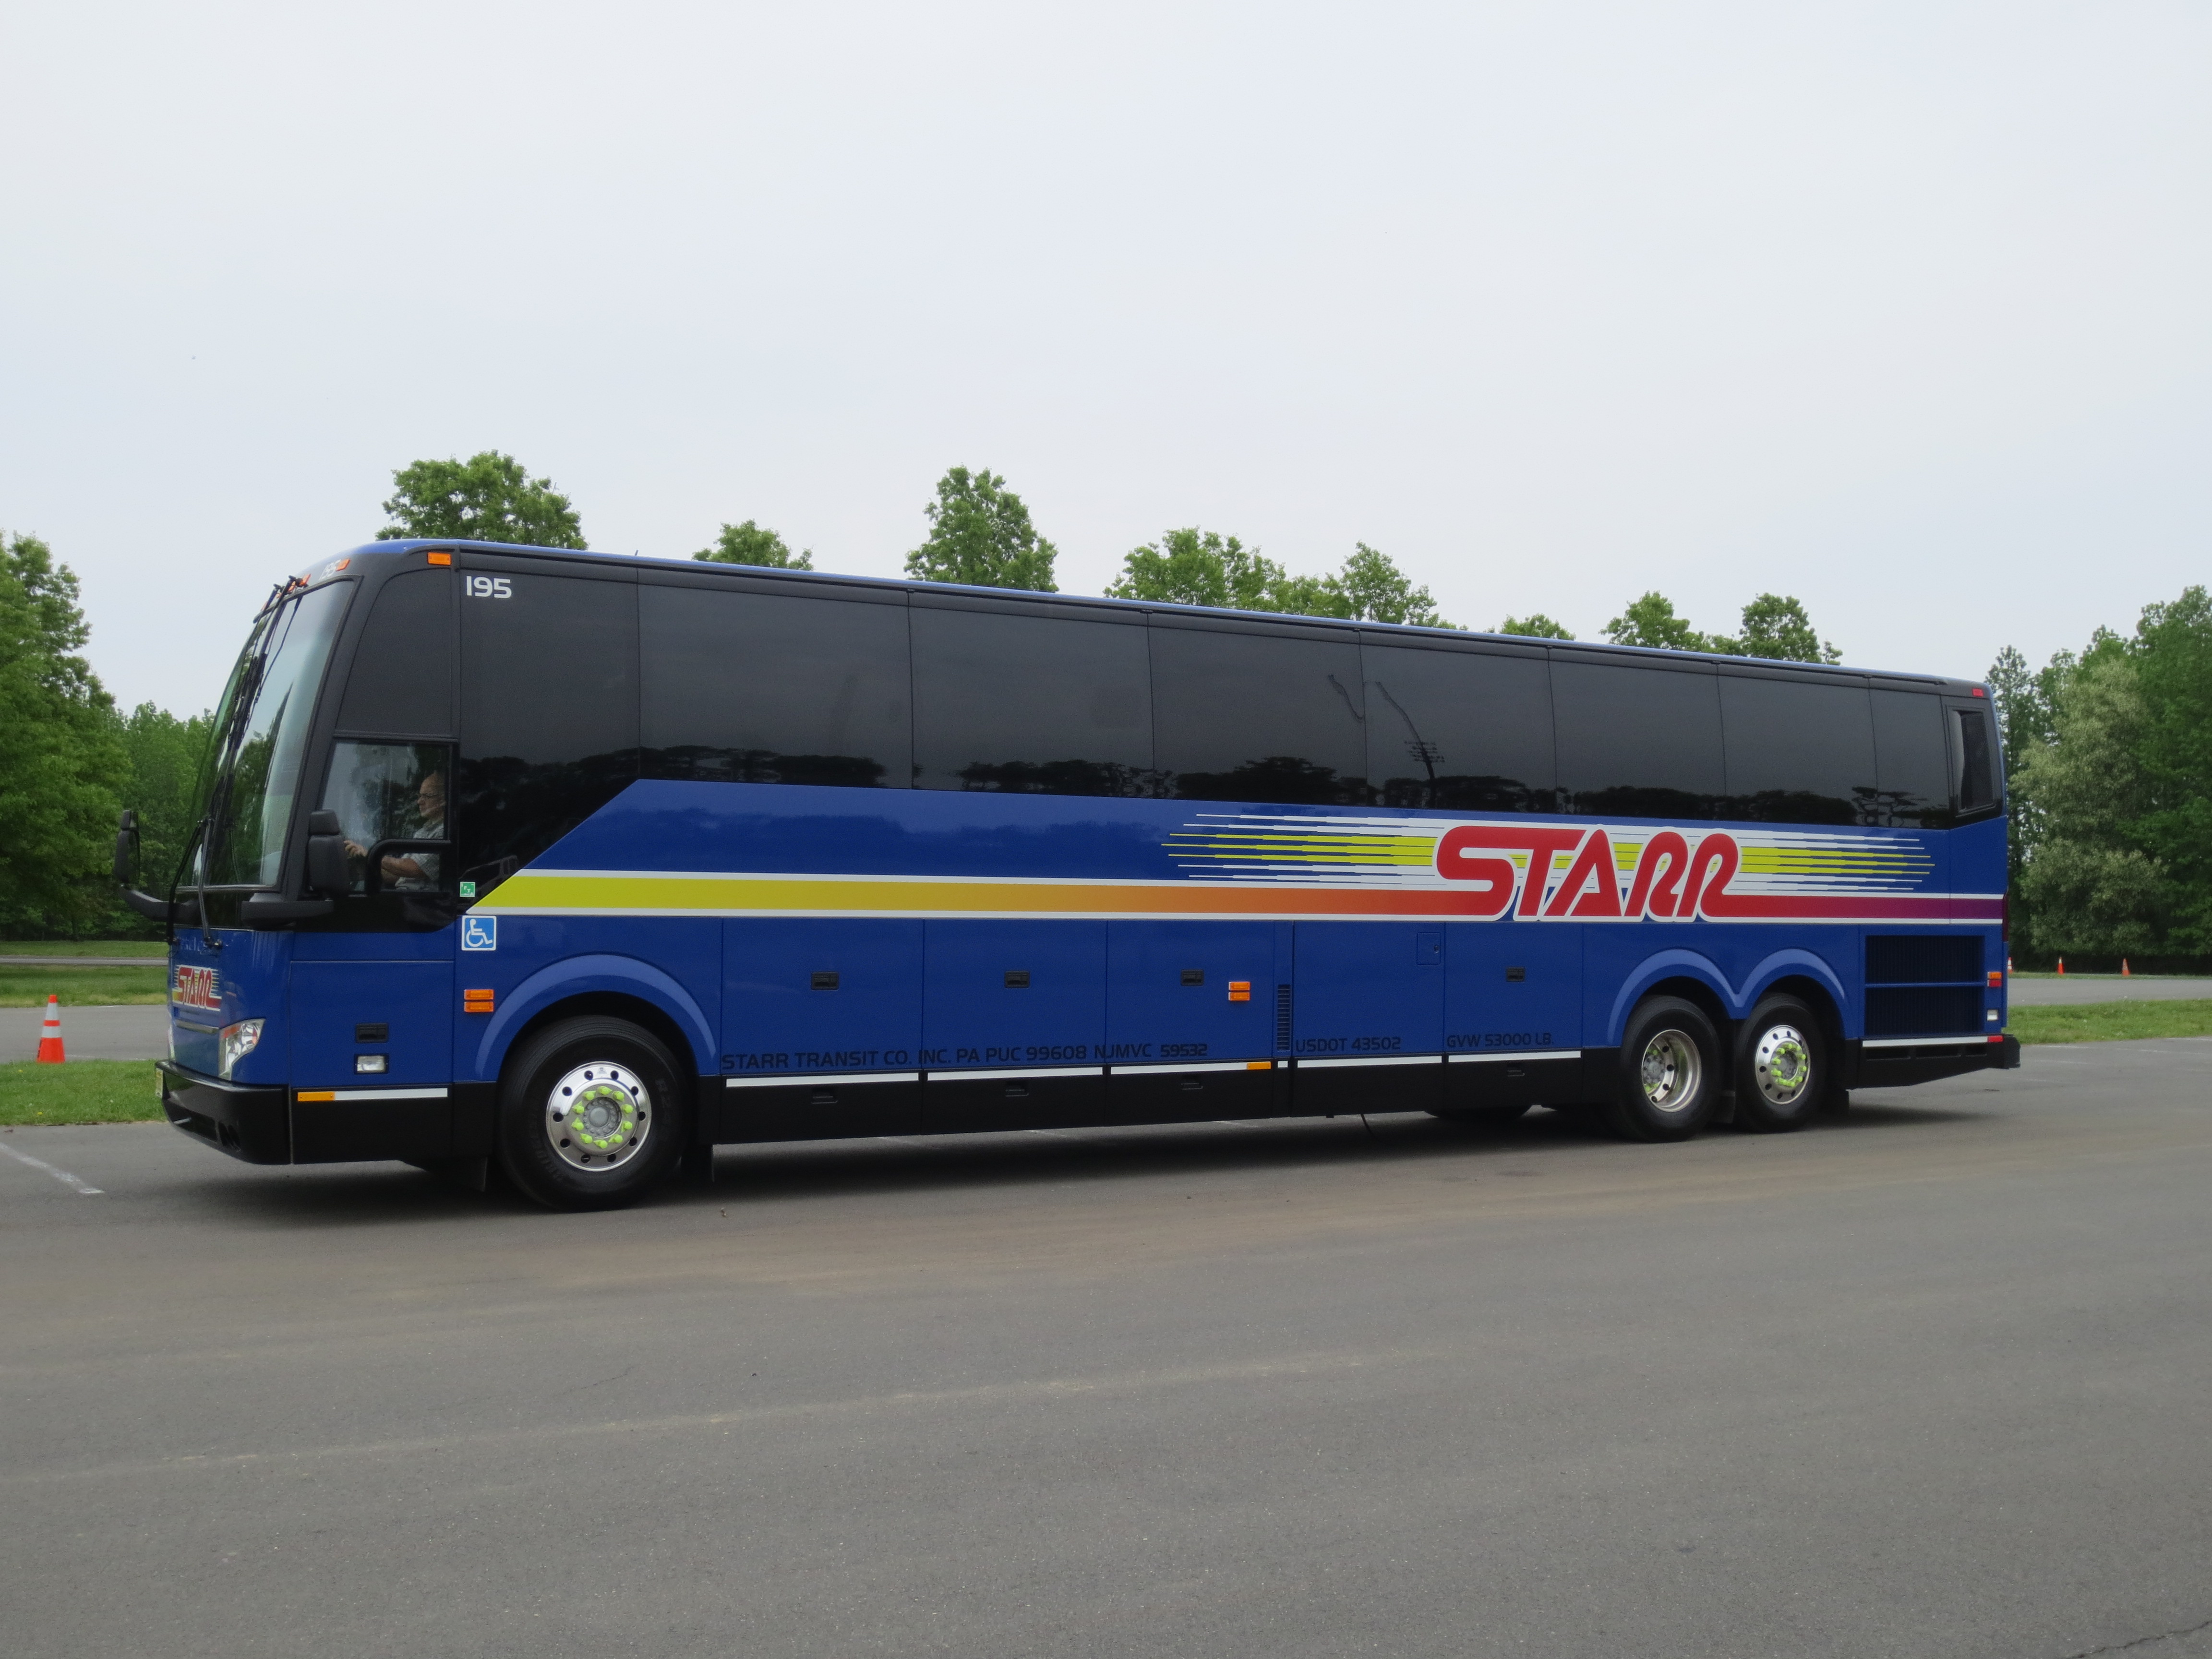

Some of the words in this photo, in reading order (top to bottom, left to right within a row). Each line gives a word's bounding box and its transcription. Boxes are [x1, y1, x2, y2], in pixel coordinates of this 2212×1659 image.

[466, 576, 512, 599] 195
[1435, 824, 1741, 919] STARR
[176, 965, 221, 1009] STARR
[1295, 1038, 1348, 1052] USDOT
[1351, 1036, 1401, 1051] 43502
[1446, 1034, 1481, 1047] GVW
[1484, 1033, 1531, 1046] 53000
[721, 1053, 789, 1069] STARR
[794, 1050, 878, 1068] TRANSIT
[883, 1050, 913, 1065] CO.
[918, 1048, 951, 1064] INC.
[956, 1048, 980, 1063] PA
[986, 1046, 1021, 1062] PUC
[1026, 1045, 1087, 1061] 99608
[1094, 1043, 1152, 1058] NJMVC
[1160, 1043, 1208, 1057] 59532
